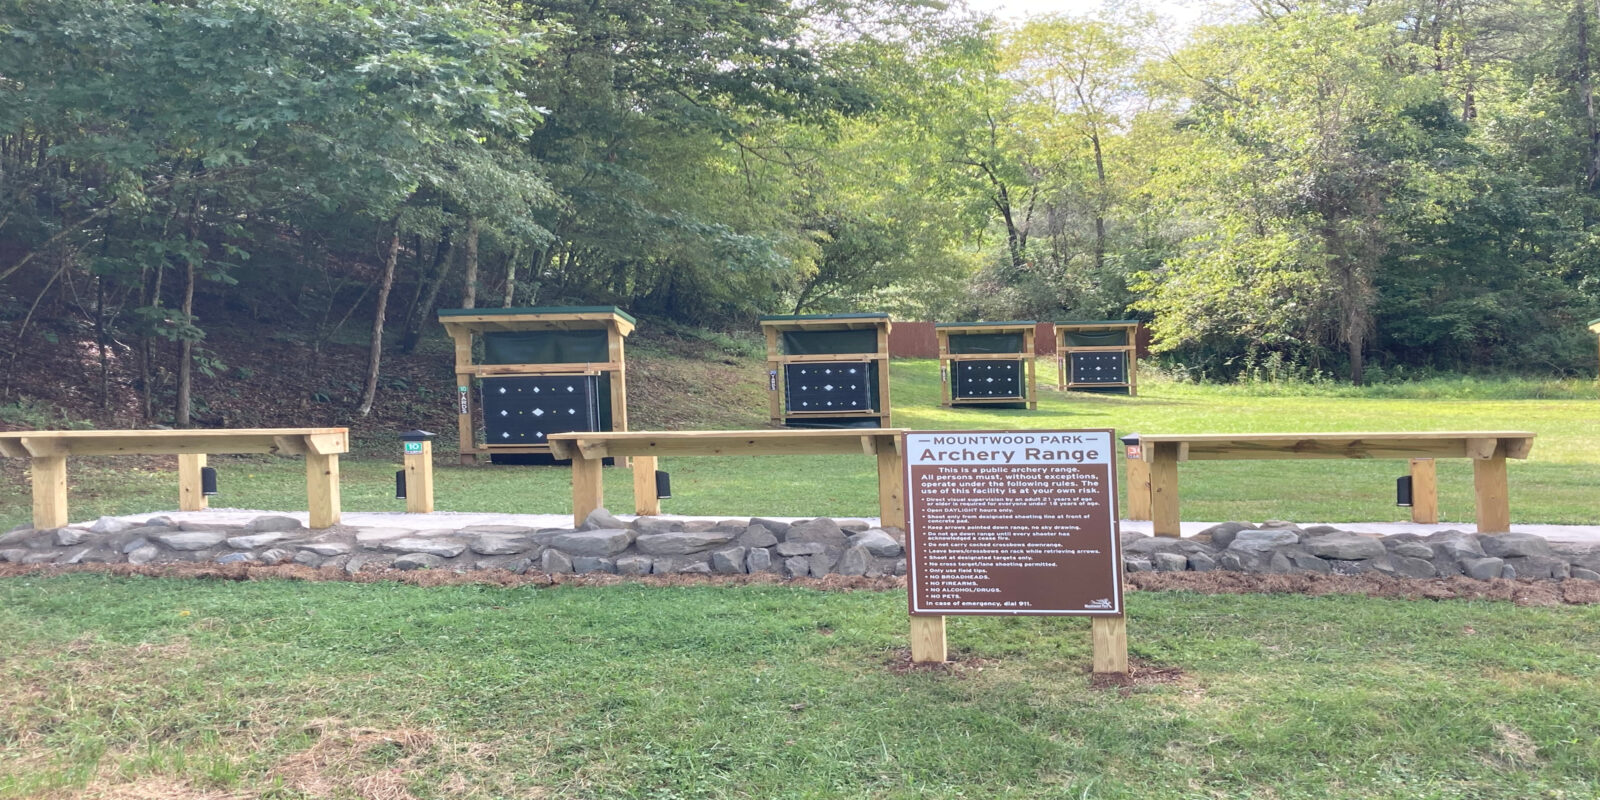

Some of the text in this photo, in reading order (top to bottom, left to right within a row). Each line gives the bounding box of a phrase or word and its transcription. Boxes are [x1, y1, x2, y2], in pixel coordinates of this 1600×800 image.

[934, 436, 1083, 445] MOUNTWOOD PARK
[920, 448, 1098, 463] Archery Range
